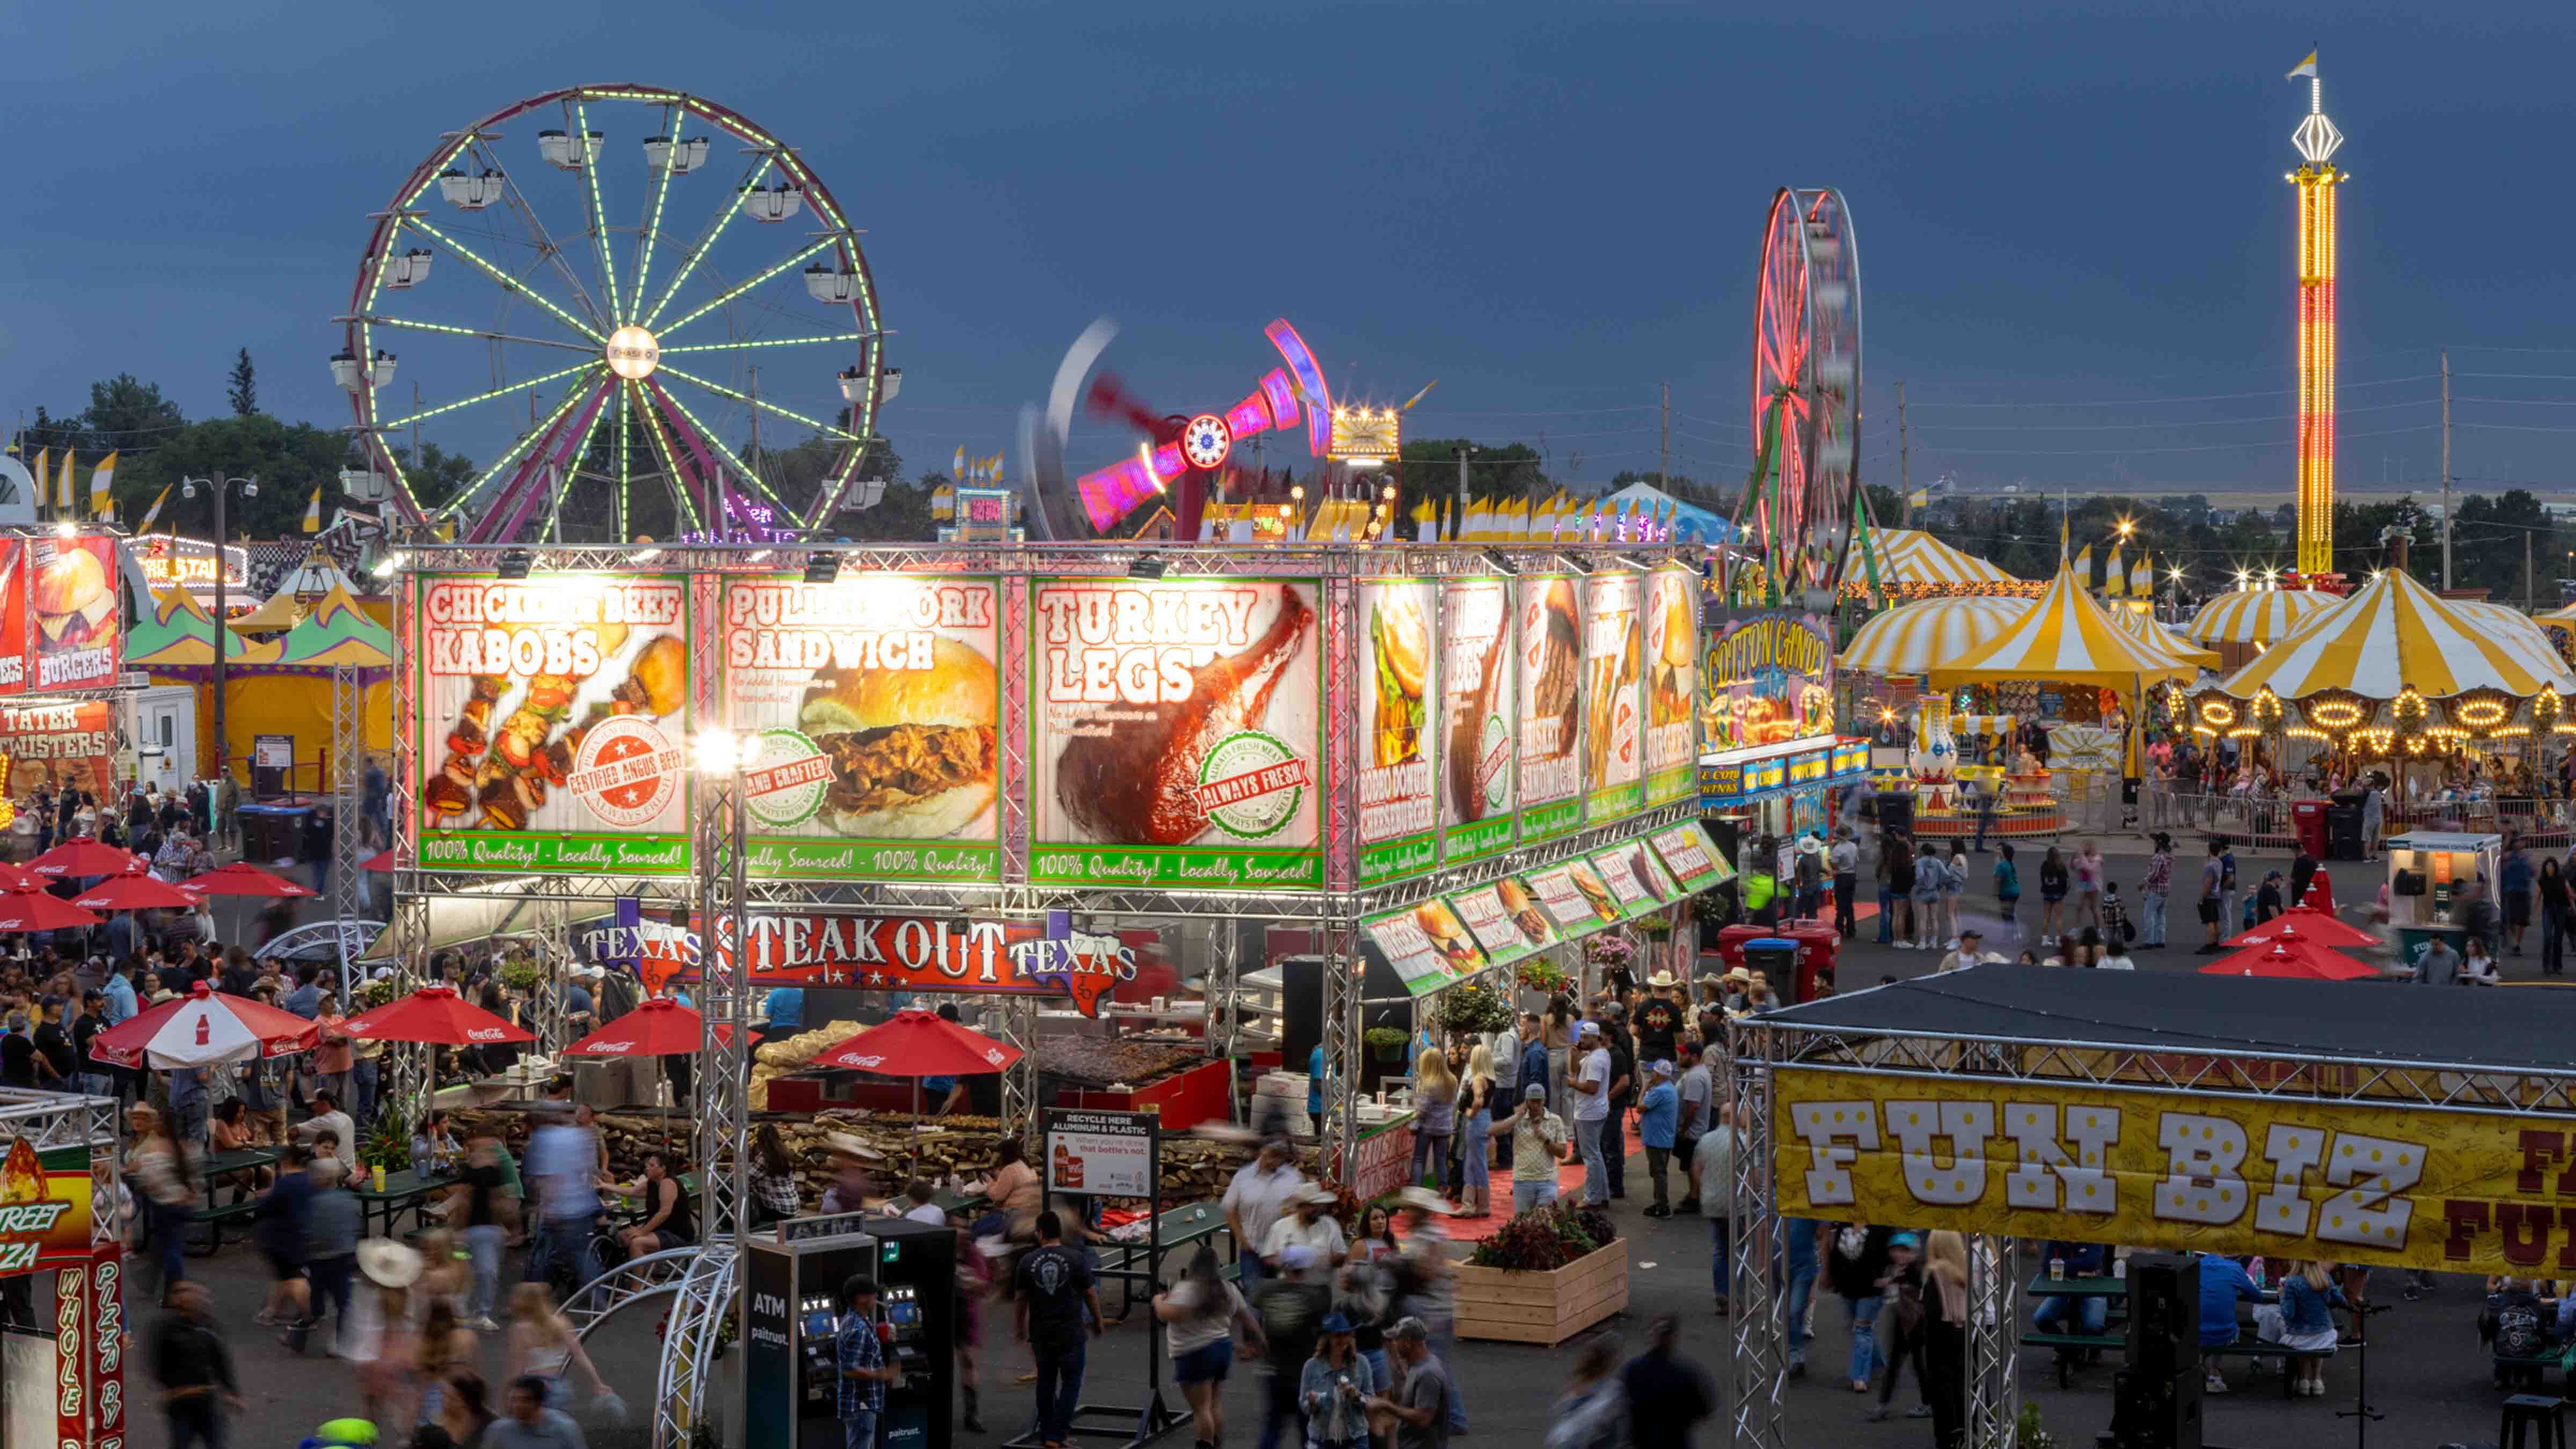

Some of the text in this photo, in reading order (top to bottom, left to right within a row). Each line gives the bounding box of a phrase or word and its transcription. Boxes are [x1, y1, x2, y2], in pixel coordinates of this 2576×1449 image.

[171, 558, 217, 581] STA
[429, 585, 682, 625] CHIC BEEF
[729, 584, 990, 628] PULL ORK
[1040, 590, 1257, 645] TURKEY
[429, 628, 600, 676] KABOBS
[728, 628, 936, 670] SANDWICH
[1708, 617, 1773, 700] COTTON
[1775, 619, 1827, 683] CANDY
[39, 647, 113, 687] BURGERS
[1046, 647, 1195, 704] LEGS
[3, 706, 78, 732] TATER
[0, 731, 106, 759] TWISTERS
[570, 748, 683, 795] CERTIFIED ANGUS BEEF
[747, 759, 826, 795] AND CRAFTED
[1202, 762, 1304, 808] ALWAYS FRESH
[426, 839, 683, 869] 100% Quality! Locally Sourced!
[788, 847, 853, 869] Sourced!
[873, 850, 919, 872] 100%
[923, 851, 995, 880] Quality!
[1037, 854, 1315, 886] 100% Quality! Locally Sourced!
[582, 914, 1138, 983] TEXAS STEAK OUT TEXAS
[467, 1028, 507, 1041] Coca-Cola
[587, 1041, 636, 1052] Coca-Cola
[838, 1052, 888, 1067] Coca-Cola
[1052, 1122, 1147, 1135] ALUMINUM & PLASTIC
[1066, 1114, 1132, 1126] RECYCLE HERE
[1099, 1146, 1128, 1154] bottle's
[1789, 1099, 2429, 1253] FUN BIZ
[793, 1219, 854, 1238] ATM
[753, 1292, 786, 1319] ATM
[801, 1298, 830, 1311] ATM
[887, 1289, 914, 1301] ATM
[97, 1261, 119, 1374] PIZZA
[58, 1267, 83, 1417] WHOLE
[751, 1326, 789, 1346] paitrust.
[102, 1380, 121, 1430] BY
[888, 1426, 921, 1440] paitrust.
